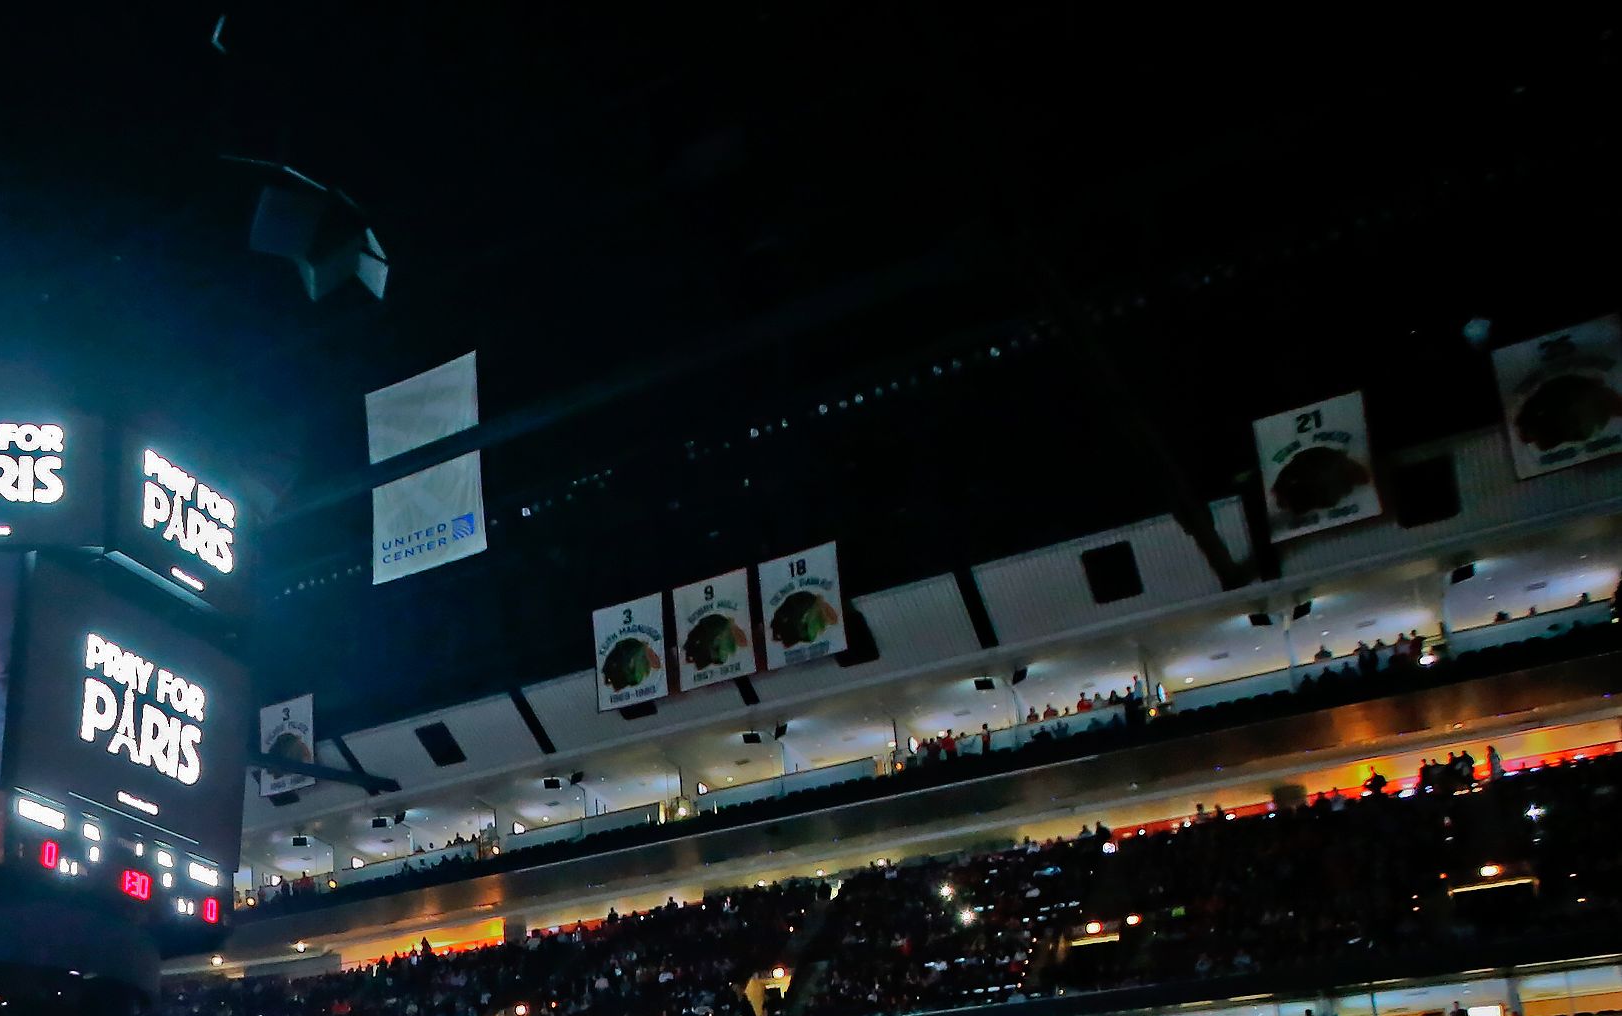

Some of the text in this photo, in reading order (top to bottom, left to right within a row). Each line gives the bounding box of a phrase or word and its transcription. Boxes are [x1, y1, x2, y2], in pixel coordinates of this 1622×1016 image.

[1296, 409, 1322, 433] 21
[143, 481, 233, 573] PARIS
[381, 523, 448, 551] UNITED
[382, 537, 448, 564] CENTER
[788, 558, 807, 577] 18
[704, 585, 715, 602] 9
[622, 608, 632, 625] 3
[85, 633, 205, 721] PRAY FOR
[80, 677, 202, 785] PARIS
[41, 841, 58, 869] 0
[203, 897, 218, 923] 0
